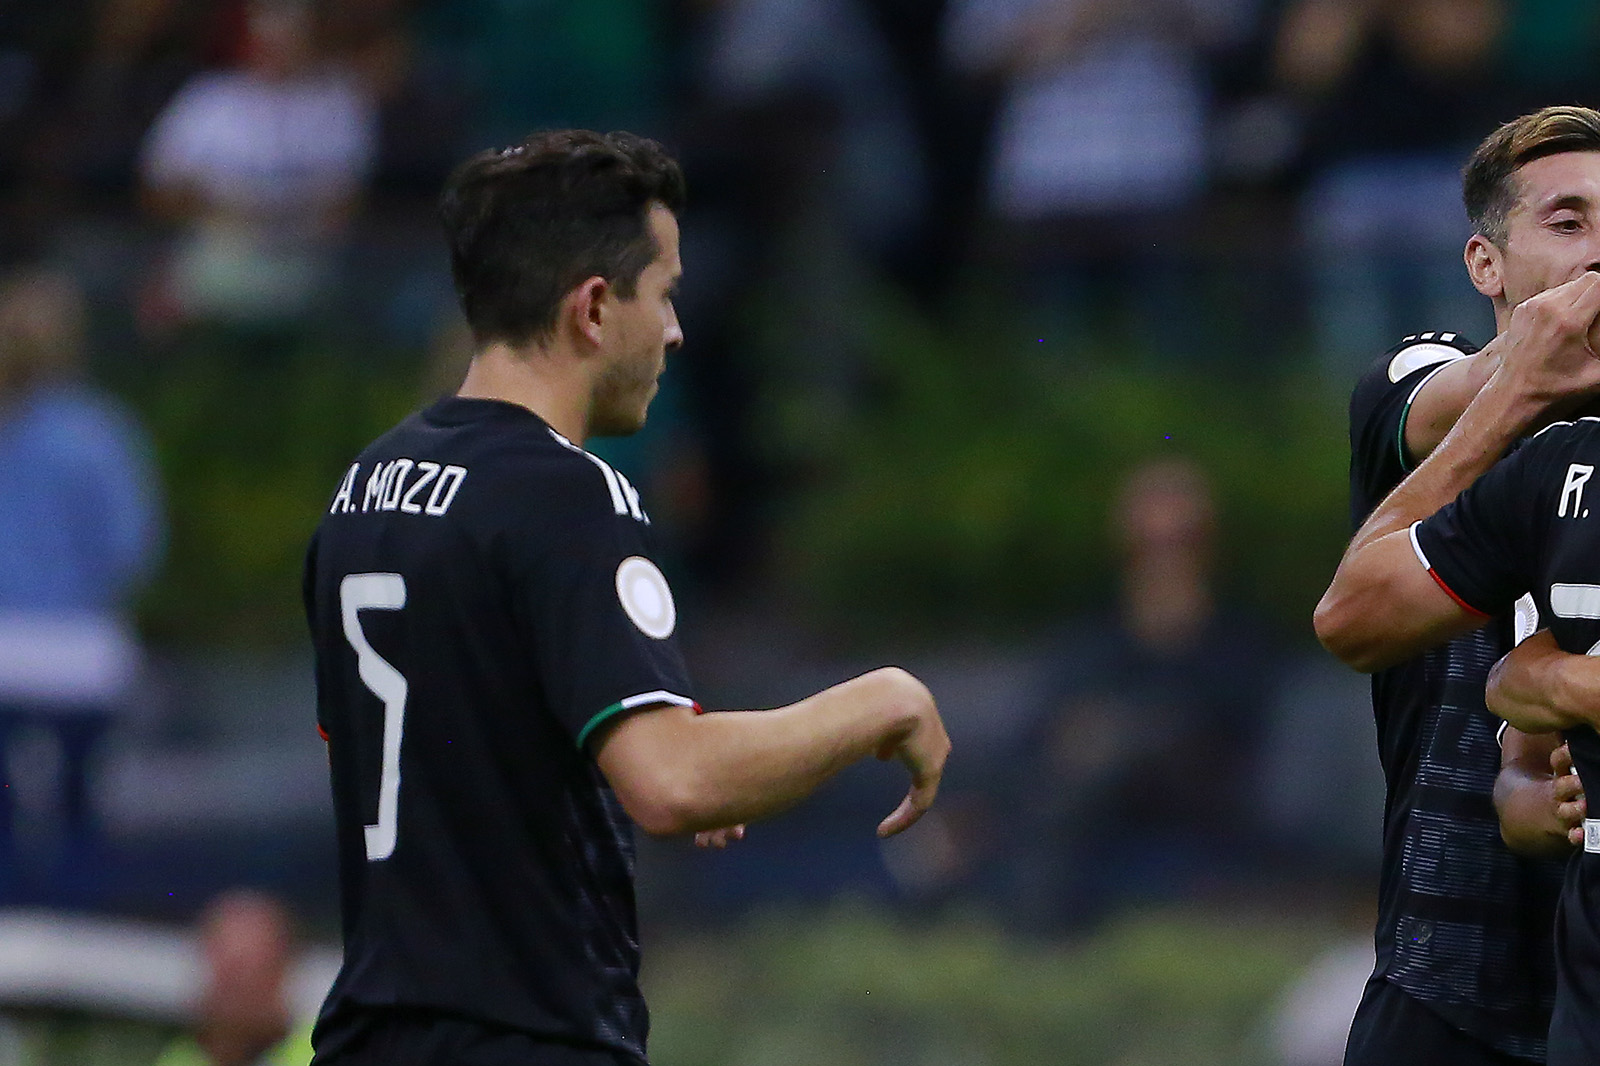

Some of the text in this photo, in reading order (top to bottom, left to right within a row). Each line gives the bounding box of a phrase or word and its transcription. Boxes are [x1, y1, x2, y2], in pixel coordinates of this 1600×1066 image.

[330, 458, 468, 517] A. MOZO
[1558, 464, 1594, 518] R.
[340, 572, 408, 862] 5
